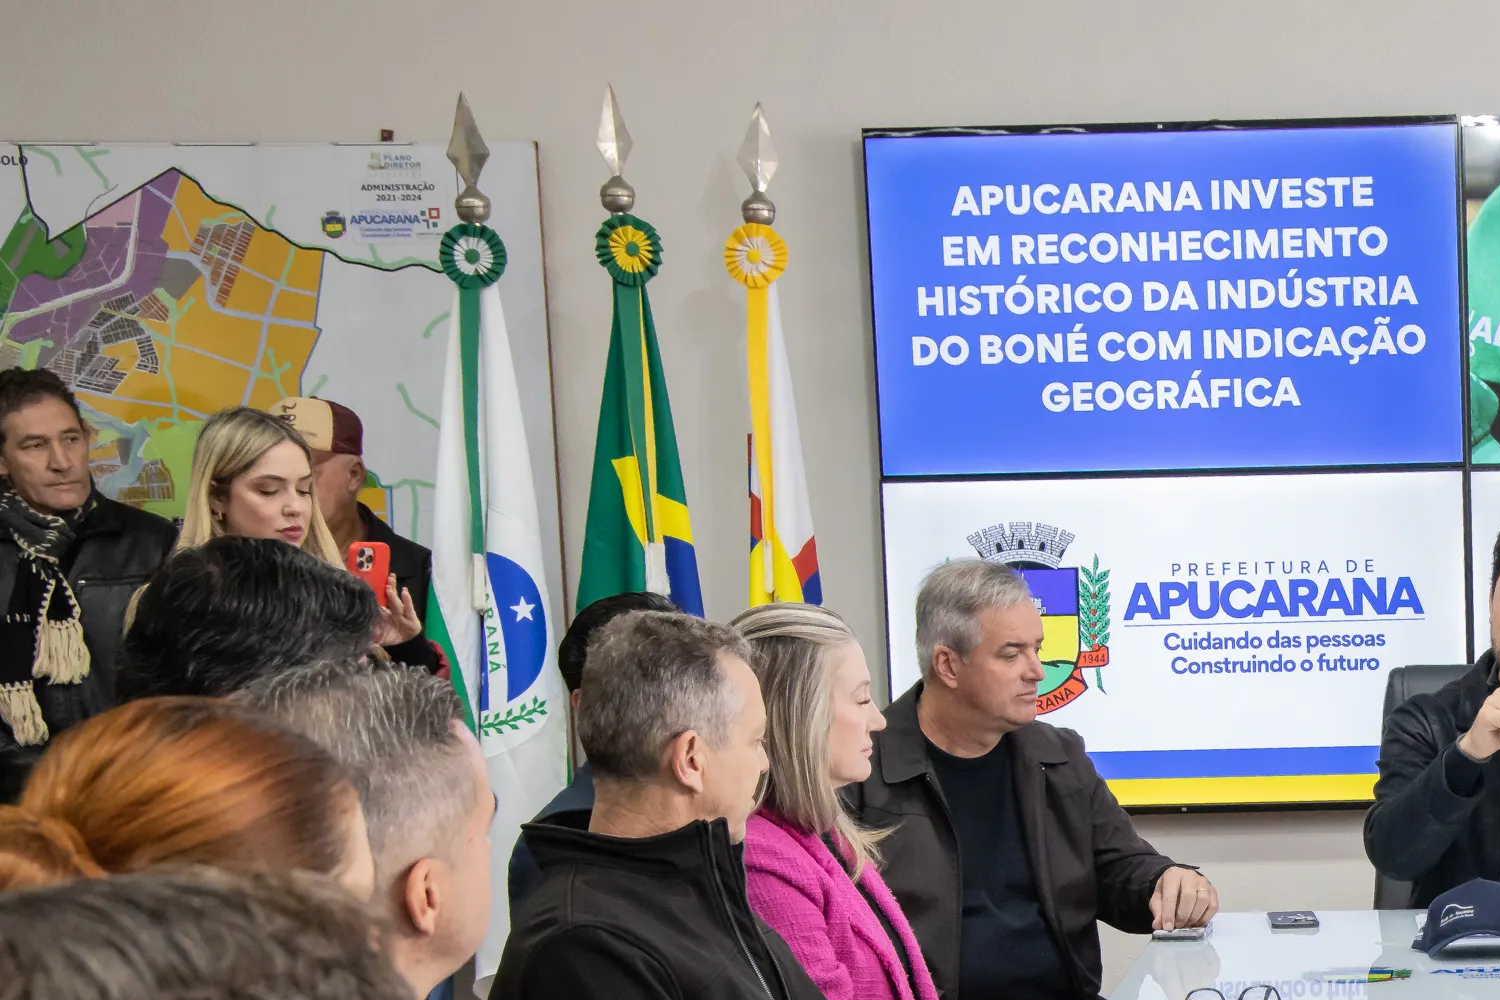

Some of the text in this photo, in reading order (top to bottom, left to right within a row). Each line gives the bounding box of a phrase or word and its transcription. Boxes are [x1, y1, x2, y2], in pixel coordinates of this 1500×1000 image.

[0, 155, 28, 166] OLO
[361, 182, 435, 192] ADMINISTRAÇÃO
[376, 194, 422, 202] 2021-2024
[951, 176, 1374, 216] APUCARANA INVESTE
[350, 214, 421, 225] APUCARANA
[942, 226, 1389, 266] EM RECONHECIMENTO
[918, 269, 1418, 317] HISTÓRICO DA INDÚSTRIA
[912, 334, 969, 367] DO
[980, 323, 1088, 365] BONÉ
[1098, 329, 1192, 362] COM
[1204, 316, 1426, 365] INDICAÇÃO
[1041, 370, 1301, 413] GEOGRÁFICA
[1171, 558, 1375, 577] PREFEITURA DE
[1123, 576, 1425, 621] APUCARANA
[1163, 630, 1386, 654] Cuidando das pessoas
[1082, 653, 1106, 663] 1944
[1171, 652, 1380, 676] Construindo o futuro
[1035, 686, 1076, 711] RANA
